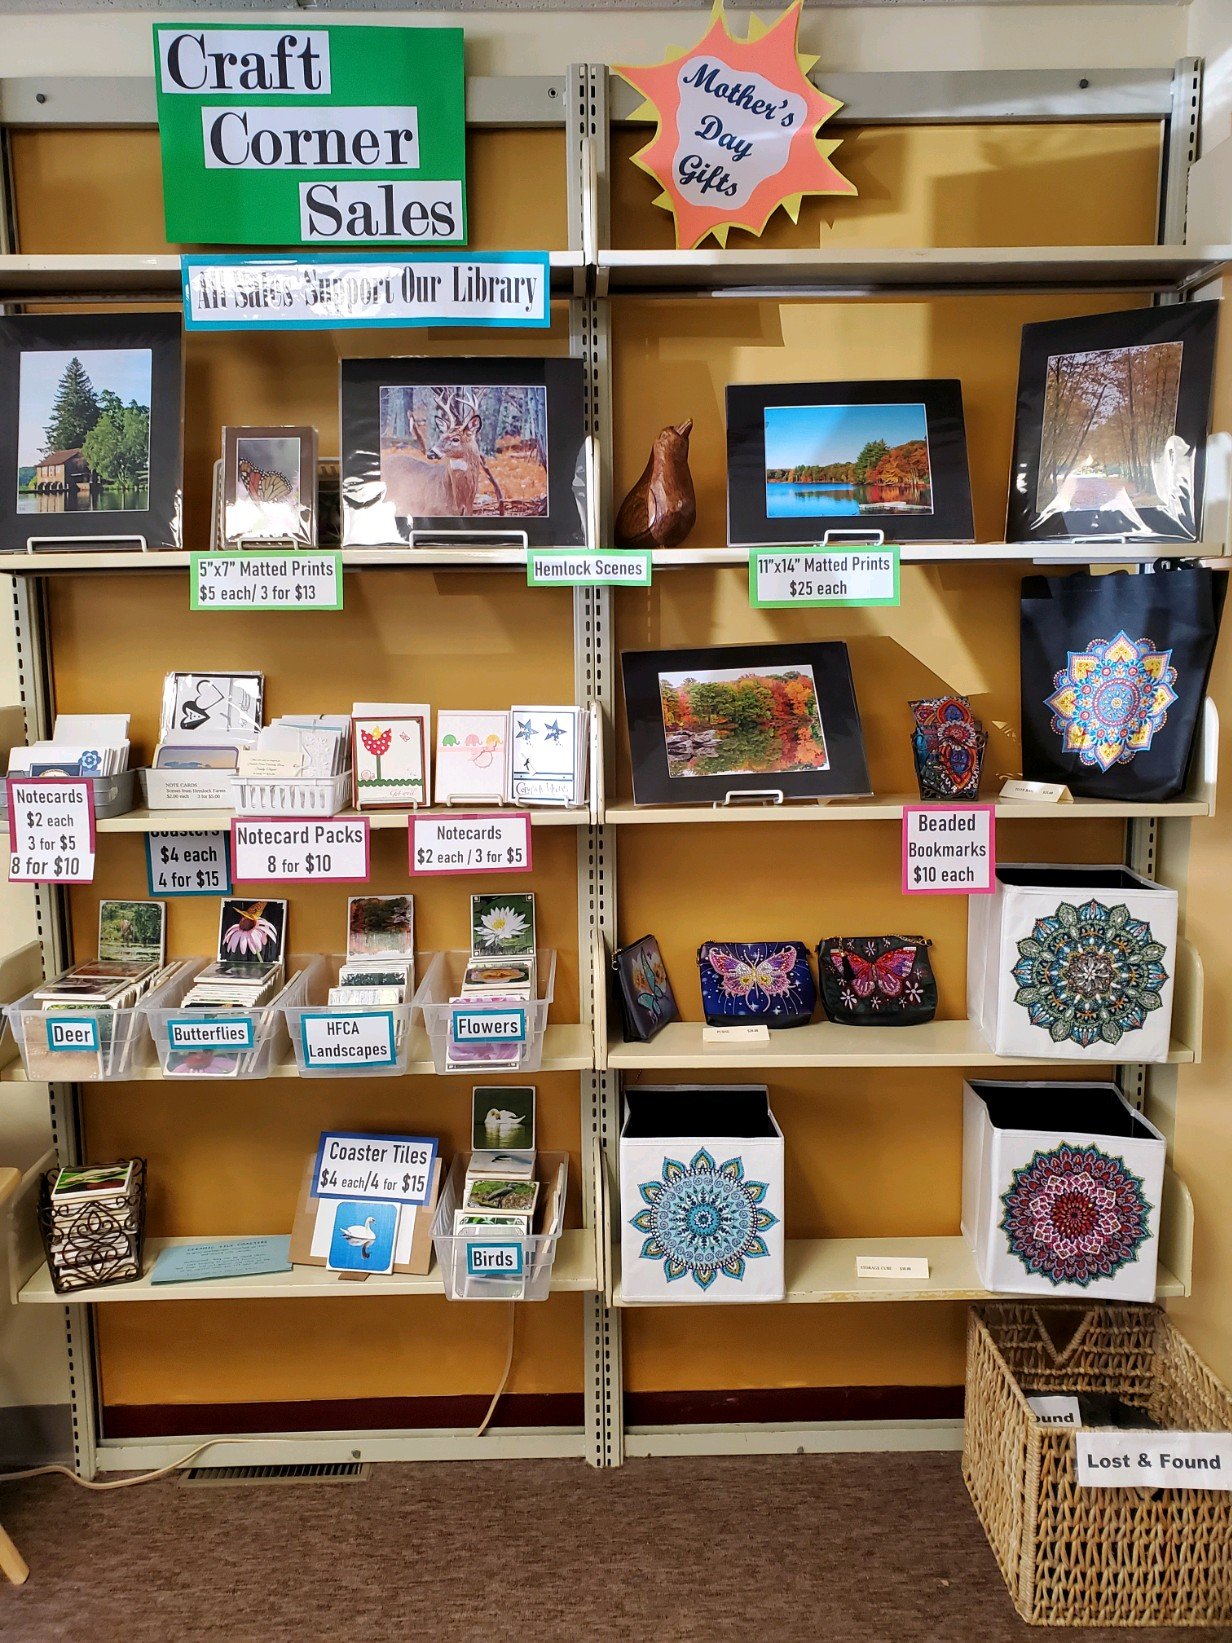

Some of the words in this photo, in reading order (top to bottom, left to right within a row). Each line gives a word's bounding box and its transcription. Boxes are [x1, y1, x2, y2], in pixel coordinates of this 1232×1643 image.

[167, 33, 322, 90] Craft
[683, 63, 794, 127] Mother's
[210, 112, 413, 165] Corner
[695, 115, 753, 162] Day
[678, 154, 738, 197] Gifts
[306, 184, 455, 236] Sales
[198, 271, 227, 309] All
[234, 271, 293, 309] Sales
[304, 269, 394, 313] Support
[402, 266, 441, 303] Our
[452, 266, 537, 312] Library
[240, 560, 287, 577] Matted
[292, 560, 333, 577] Prints
[535, 560, 591, 577] Hemlock
[595, 559, 643, 575] Scenes
[804, 556, 848, 572] Matted
[852, 556, 890, 571] Prints
[199, 584, 216, 601] $5
[221, 584, 256, 602] each/
[261, 586, 268, 600] 3
[272, 585, 290, 600] for
[295, 584, 316, 601] $13
[789, 580, 813, 597] $25
[817, 580, 847, 595] each
[16, 789, 83, 804] Notecards
[26, 811, 43, 828] $2
[47, 814, 74, 827] each
[918, 814, 976, 832] Beaded
[238, 826, 309, 845] Notecard
[315, 825, 363, 843] Packs
[437, 826, 502, 840] Notecards
[28, 836, 36, 850] 3
[40, 838, 55, 850] for
[60, 834, 76, 852] $5
[909, 841, 986, 858] Bookmarks
[161, 846, 179, 864] $4
[184, 846, 217, 862] each
[267, 855, 276, 873] 8
[282, 859, 299, 873] for
[305, 853, 331, 874] $10
[417, 847, 433, 865] $2
[437, 851, 463, 863] each
[475, 848, 482, 863] 3
[487, 851, 502, 863] for
[507, 846, 523, 864] $5
[11, 857, 20, 874] 8
[26, 857, 48, 875] for
[54, 855, 80, 877] $10
[913, 865, 936, 883] $10
[941, 866, 975, 882] each
[159, 872, 167, 887] 4
[171, 872, 191, 887] for
[196, 869, 219, 888] $15
[53, 1026, 91, 1043] Deer
[174, 1026, 245, 1041] Butterflies
[327, 1021, 360, 1036] HFCA
[459, 1018, 518, 1034] Flowers
[309, 1042, 388, 1059] Landscapes
[329, 1141, 387, 1162] Coaster
[393, 1144, 428, 1164] Tiles
[320, 1168, 337, 1188] $4
[341, 1170, 379, 1192] each/4
[383, 1178, 397, 1191] for
[401, 1173, 425, 1193] $15
[473, 1251, 513, 1267] Birds
[1087, 1454, 1130, 1469] Lost
[1137, 1453, 1152, 1468] &
[1159, 1454, 1221, 1470] Found
